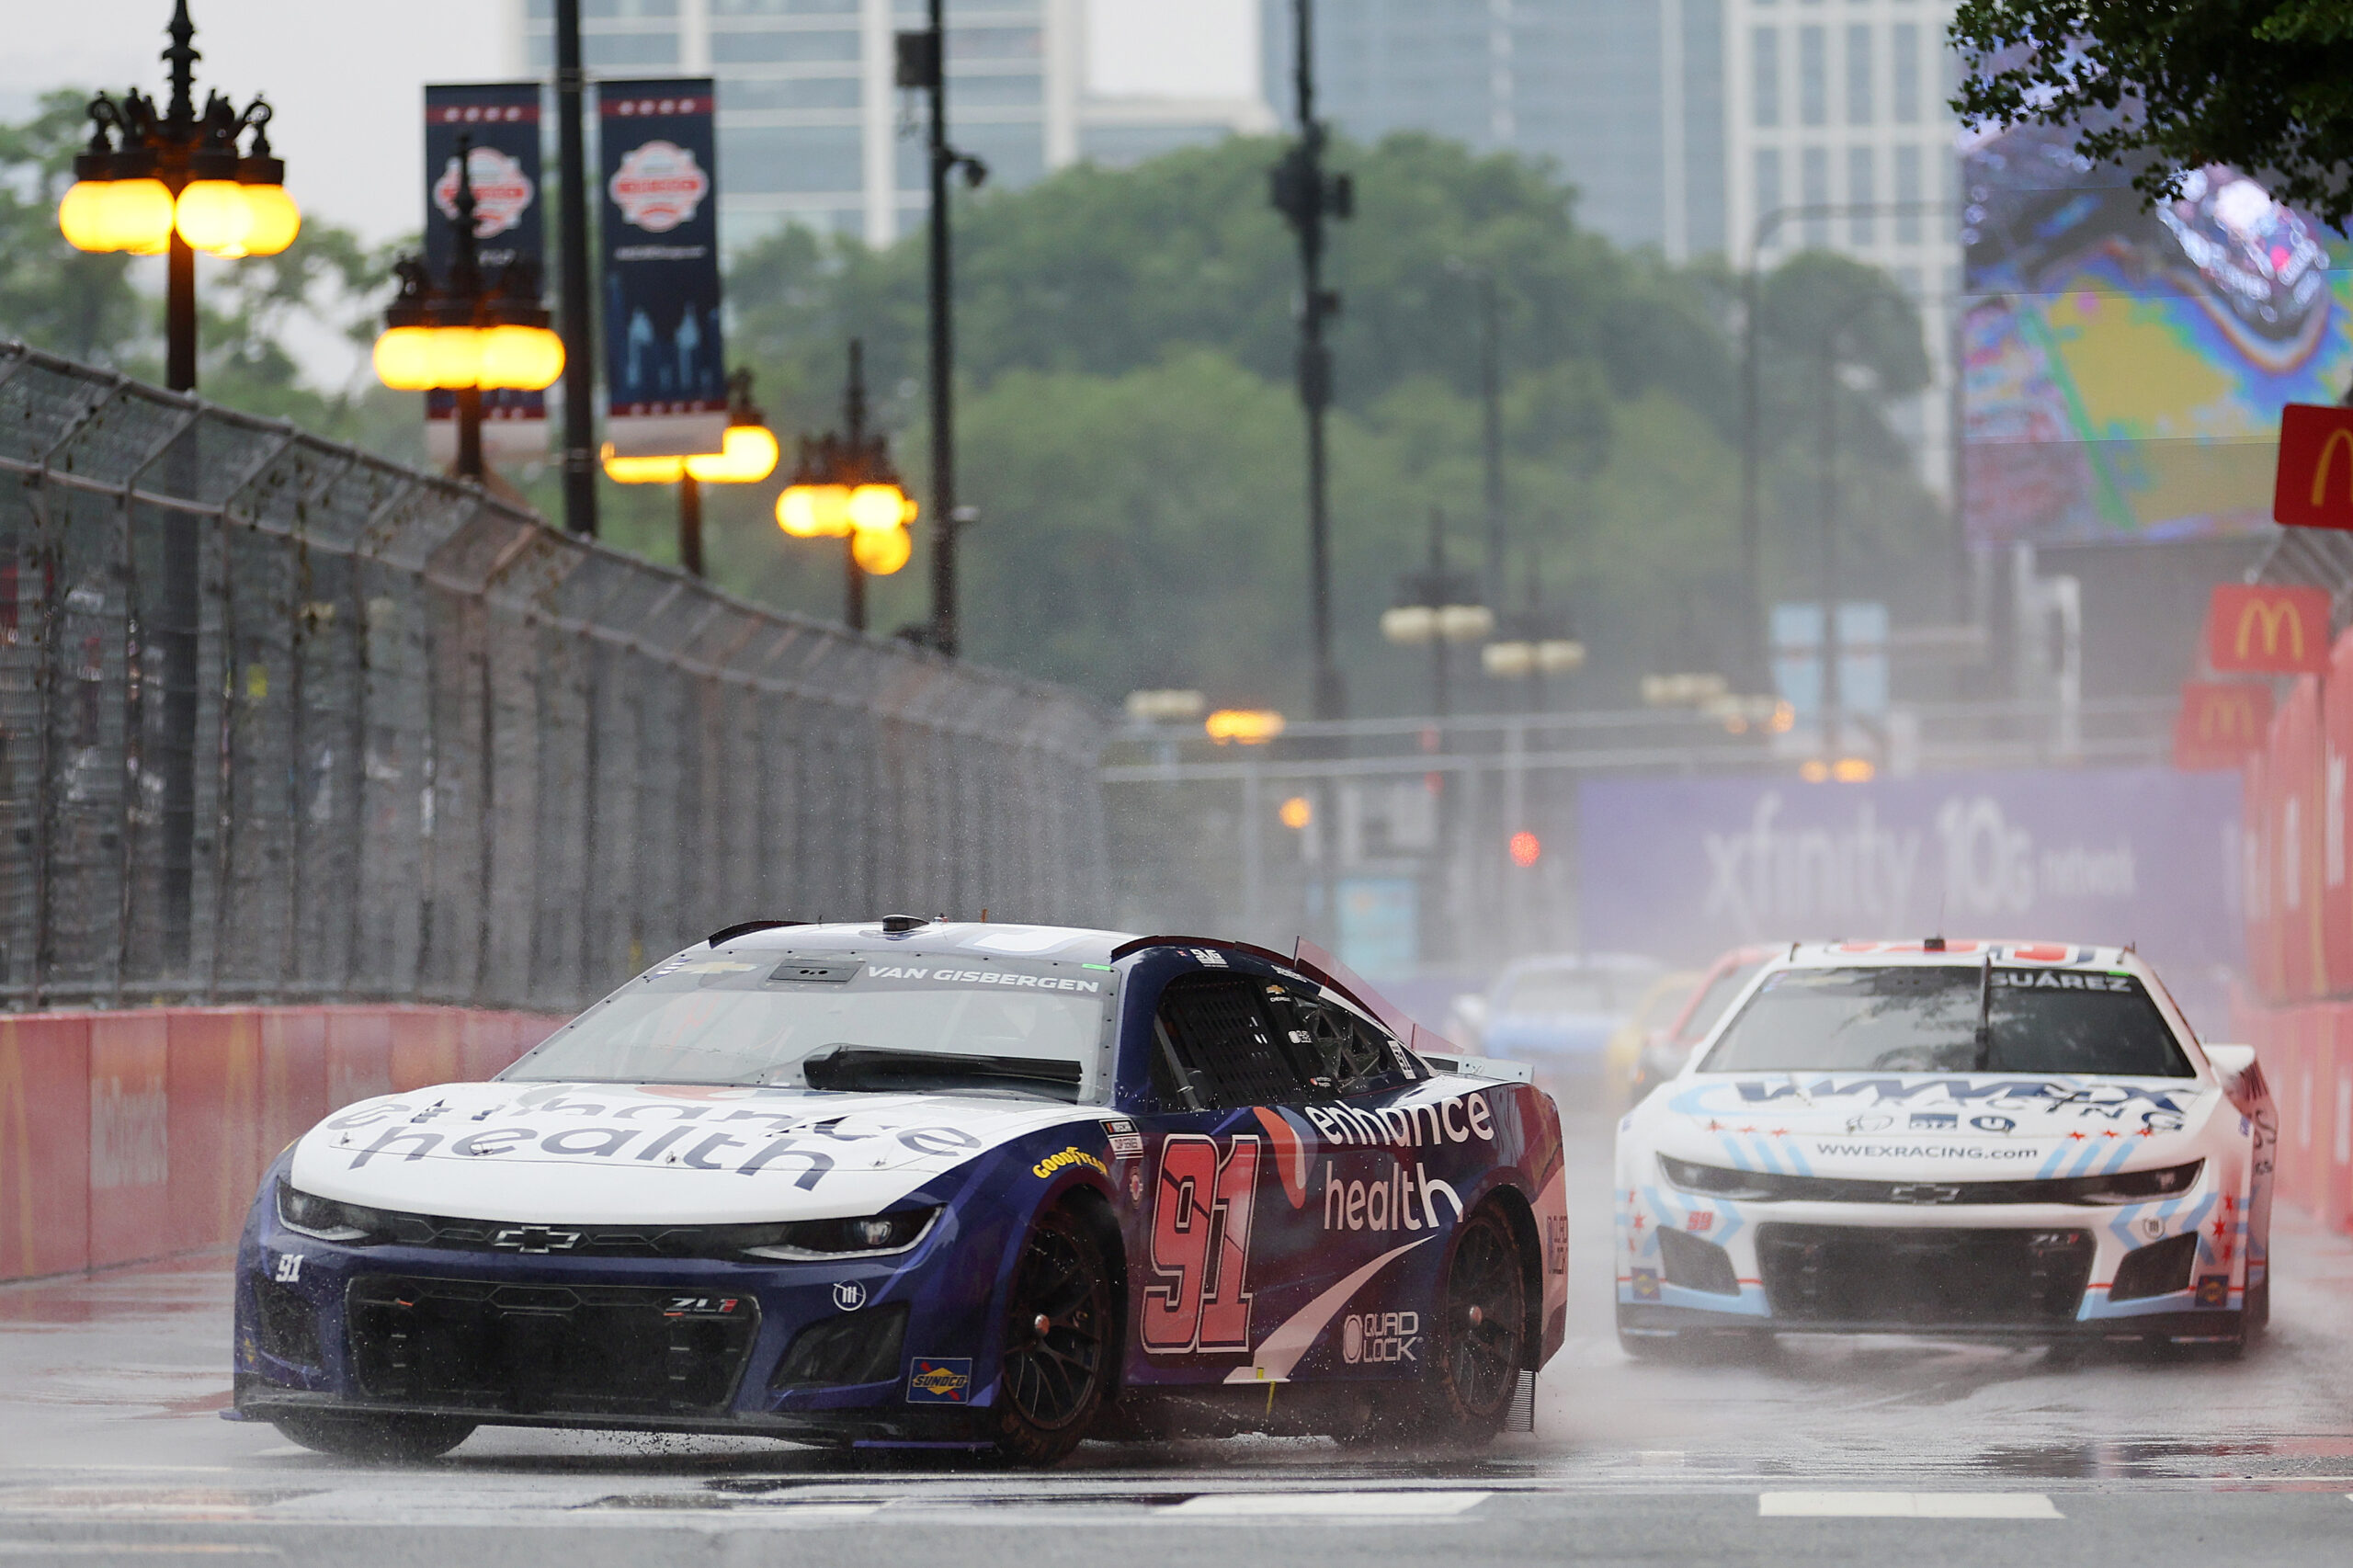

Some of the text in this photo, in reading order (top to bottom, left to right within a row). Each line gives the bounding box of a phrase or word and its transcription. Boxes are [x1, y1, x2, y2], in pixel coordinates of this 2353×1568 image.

[1702, 789, 1922, 934] xfinity
[867, 965, 1100, 992] VAN GISBERGEN
[1305, 1093, 1495, 1147] enhance
[347, 1125, 835, 1191] health
[1032, 1146, 1108, 1178] GOODYEAR
[1817, 1143, 2038, 1159] WWEXRACING.com
[1324, 1161, 1464, 1231] health
[1140, 1133, 1260, 1354] 91
[275, 1253, 304, 1283] 91
[1364, 1312, 1419, 1336] QUAD
[1363, 1336, 1418, 1363] LOCK
[914, 1373, 968, 1389] SUNOCO
